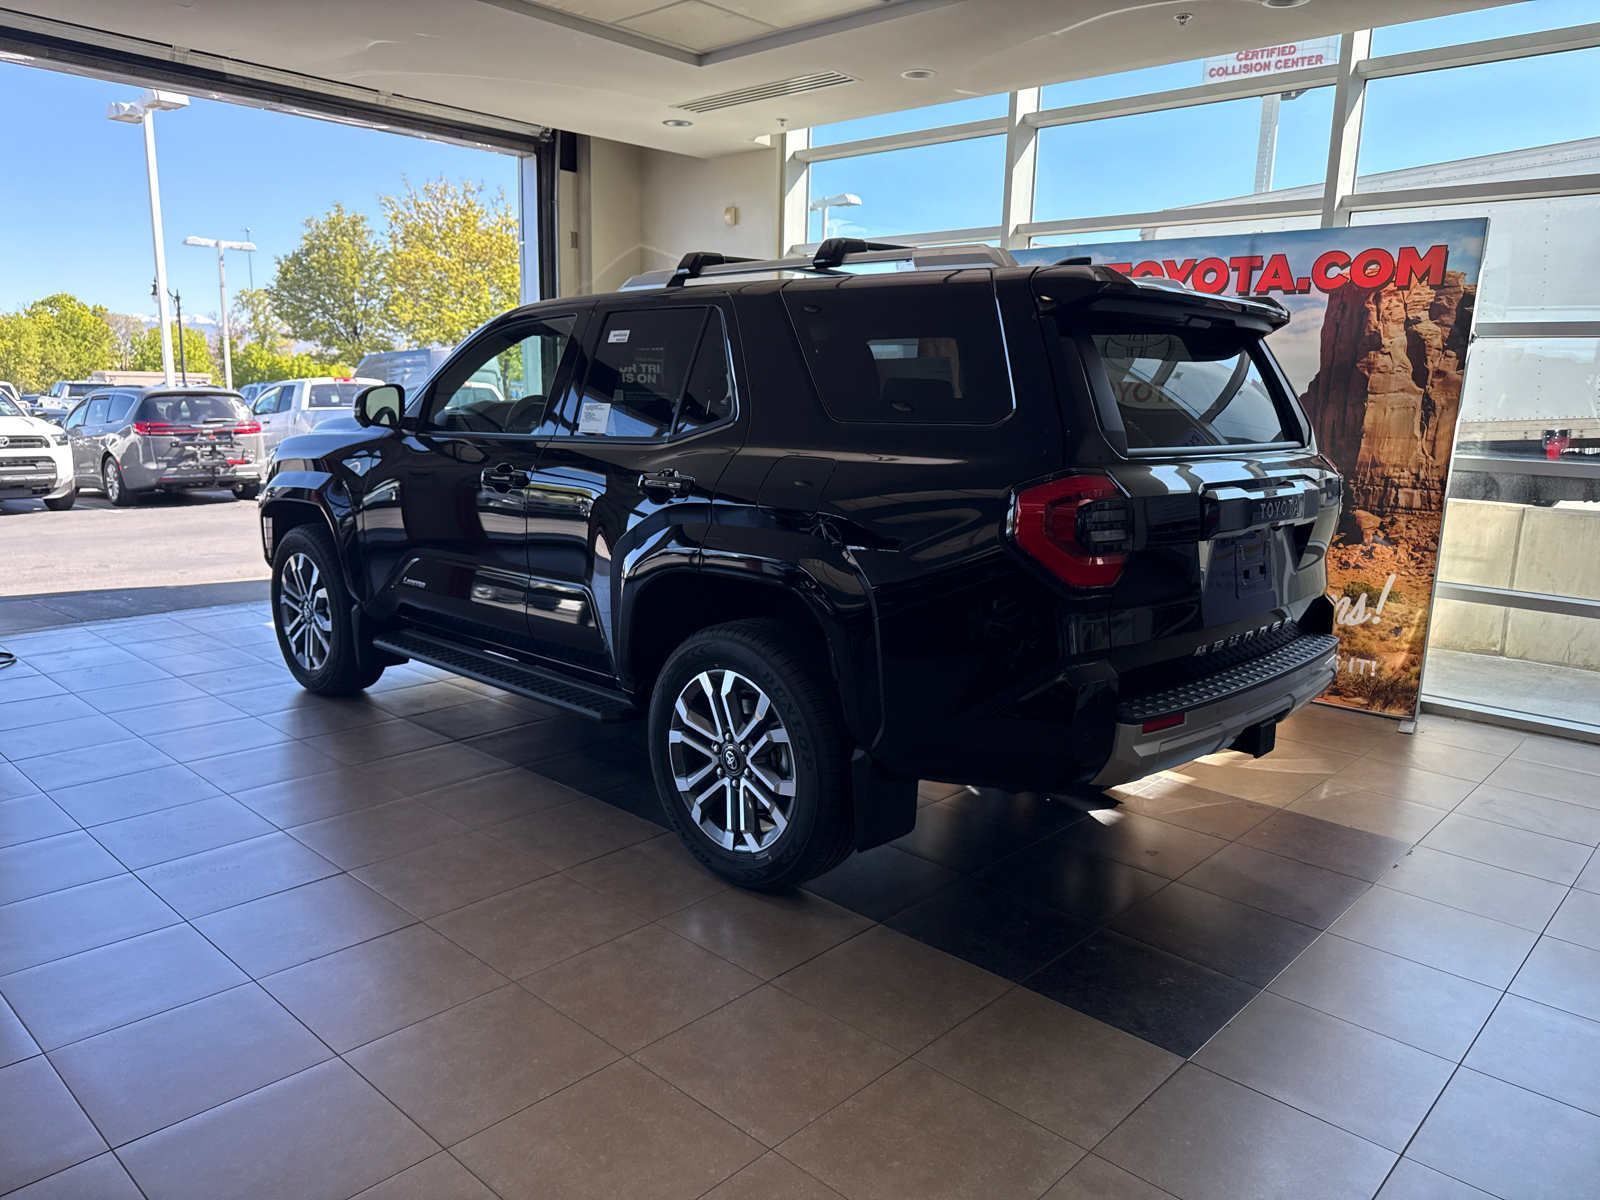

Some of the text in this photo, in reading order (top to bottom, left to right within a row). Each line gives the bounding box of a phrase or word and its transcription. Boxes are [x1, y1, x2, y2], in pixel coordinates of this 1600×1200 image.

[1236, 45, 1297, 62] CERTIFIED
[1208, 54, 1323, 78] COLLISION CENTER
[1104, 244, 1448, 297] YOTA.COM
[621, 373, 657, 384] IS ON
[1260, 498, 1300, 519] TOYOTA
[1348, 657, 1377, 677] IT!
[762, 671, 815, 771] DUNLOP
